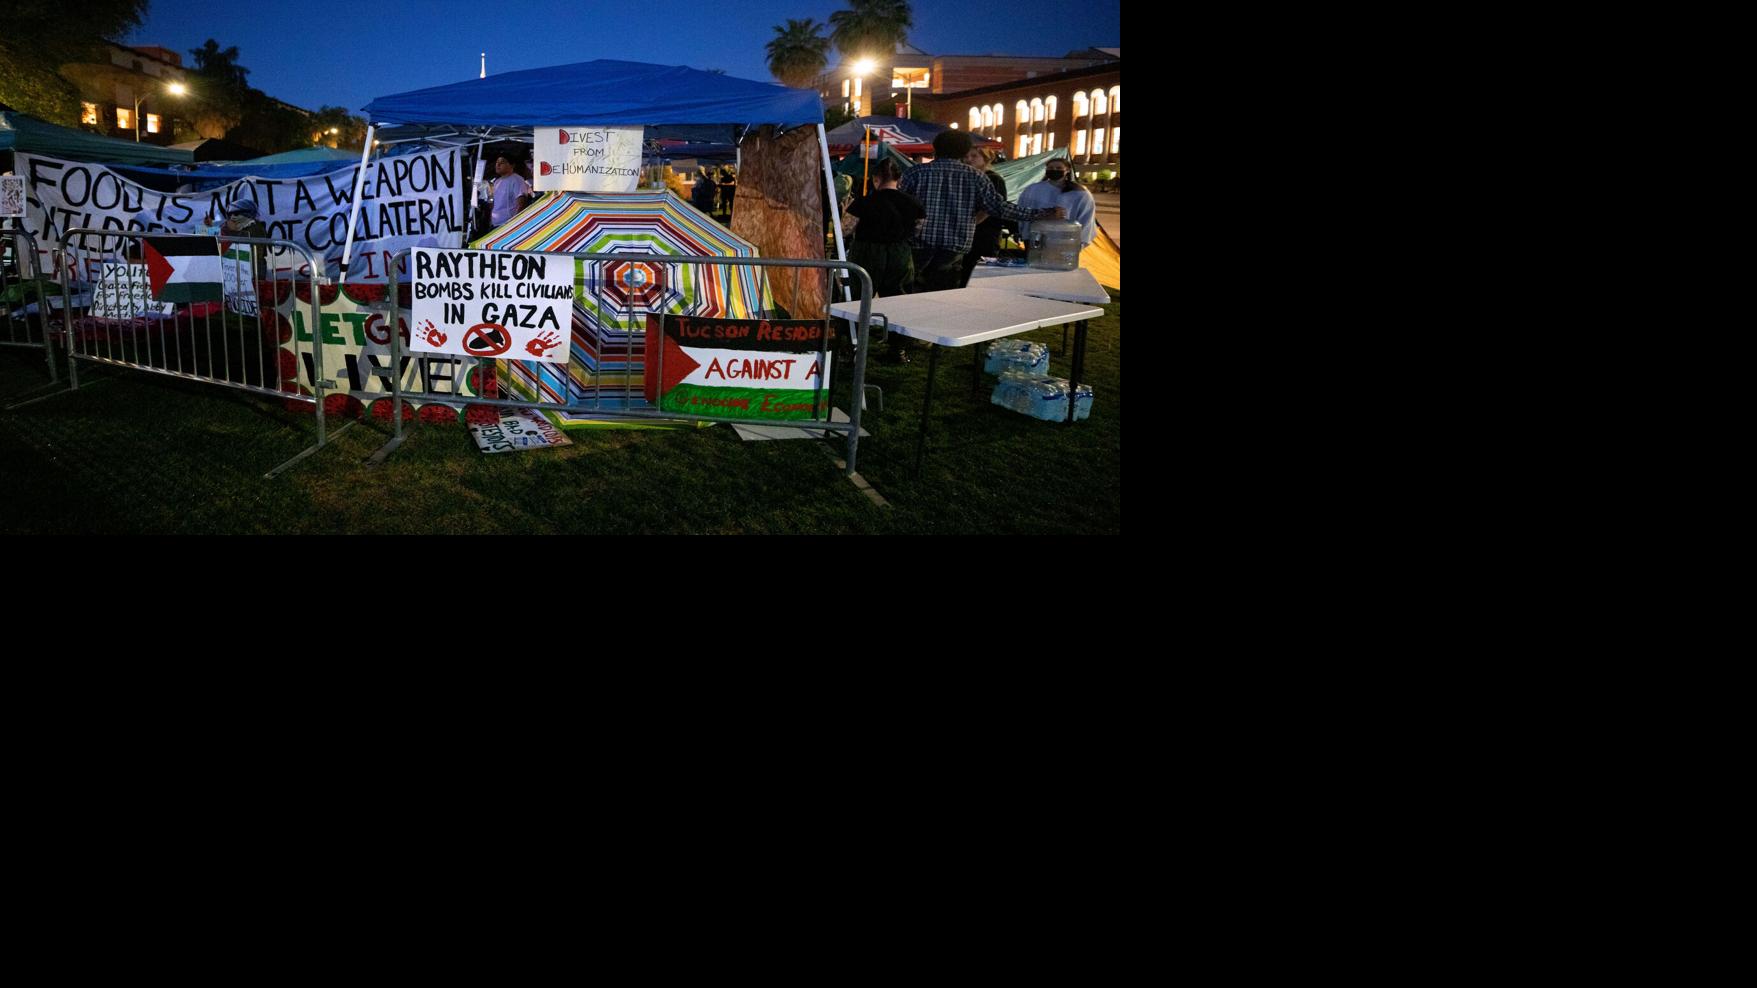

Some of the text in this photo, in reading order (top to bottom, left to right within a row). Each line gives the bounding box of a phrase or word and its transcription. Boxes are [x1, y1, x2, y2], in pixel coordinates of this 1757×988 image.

[559, 128, 616, 145] DIVEST
[574, 148, 604, 157] FROM
[541, 161, 640, 177] DEHUMANIZATION
[29, 159, 143, 213] FOOD
[156, 195, 194, 223] IS
[209, 179, 282, 220] NOT
[294, 179, 316, 214] A
[324, 150, 456, 206] WEAPON
[261, 220, 303, 256] OT
[304, 194, 463, 251] COLLATERAL
[415, 251, 547, 281] RAYTHEON
[415, 282, 575, 301] BOMBS KILL CIVILIANS
[291, 311, 370, 347] LET
[444, 303, 561, 331] IN GAZA
[674, 318, 750, 339] TUCSON
[704, 357, 822, 381] AGAINST A
